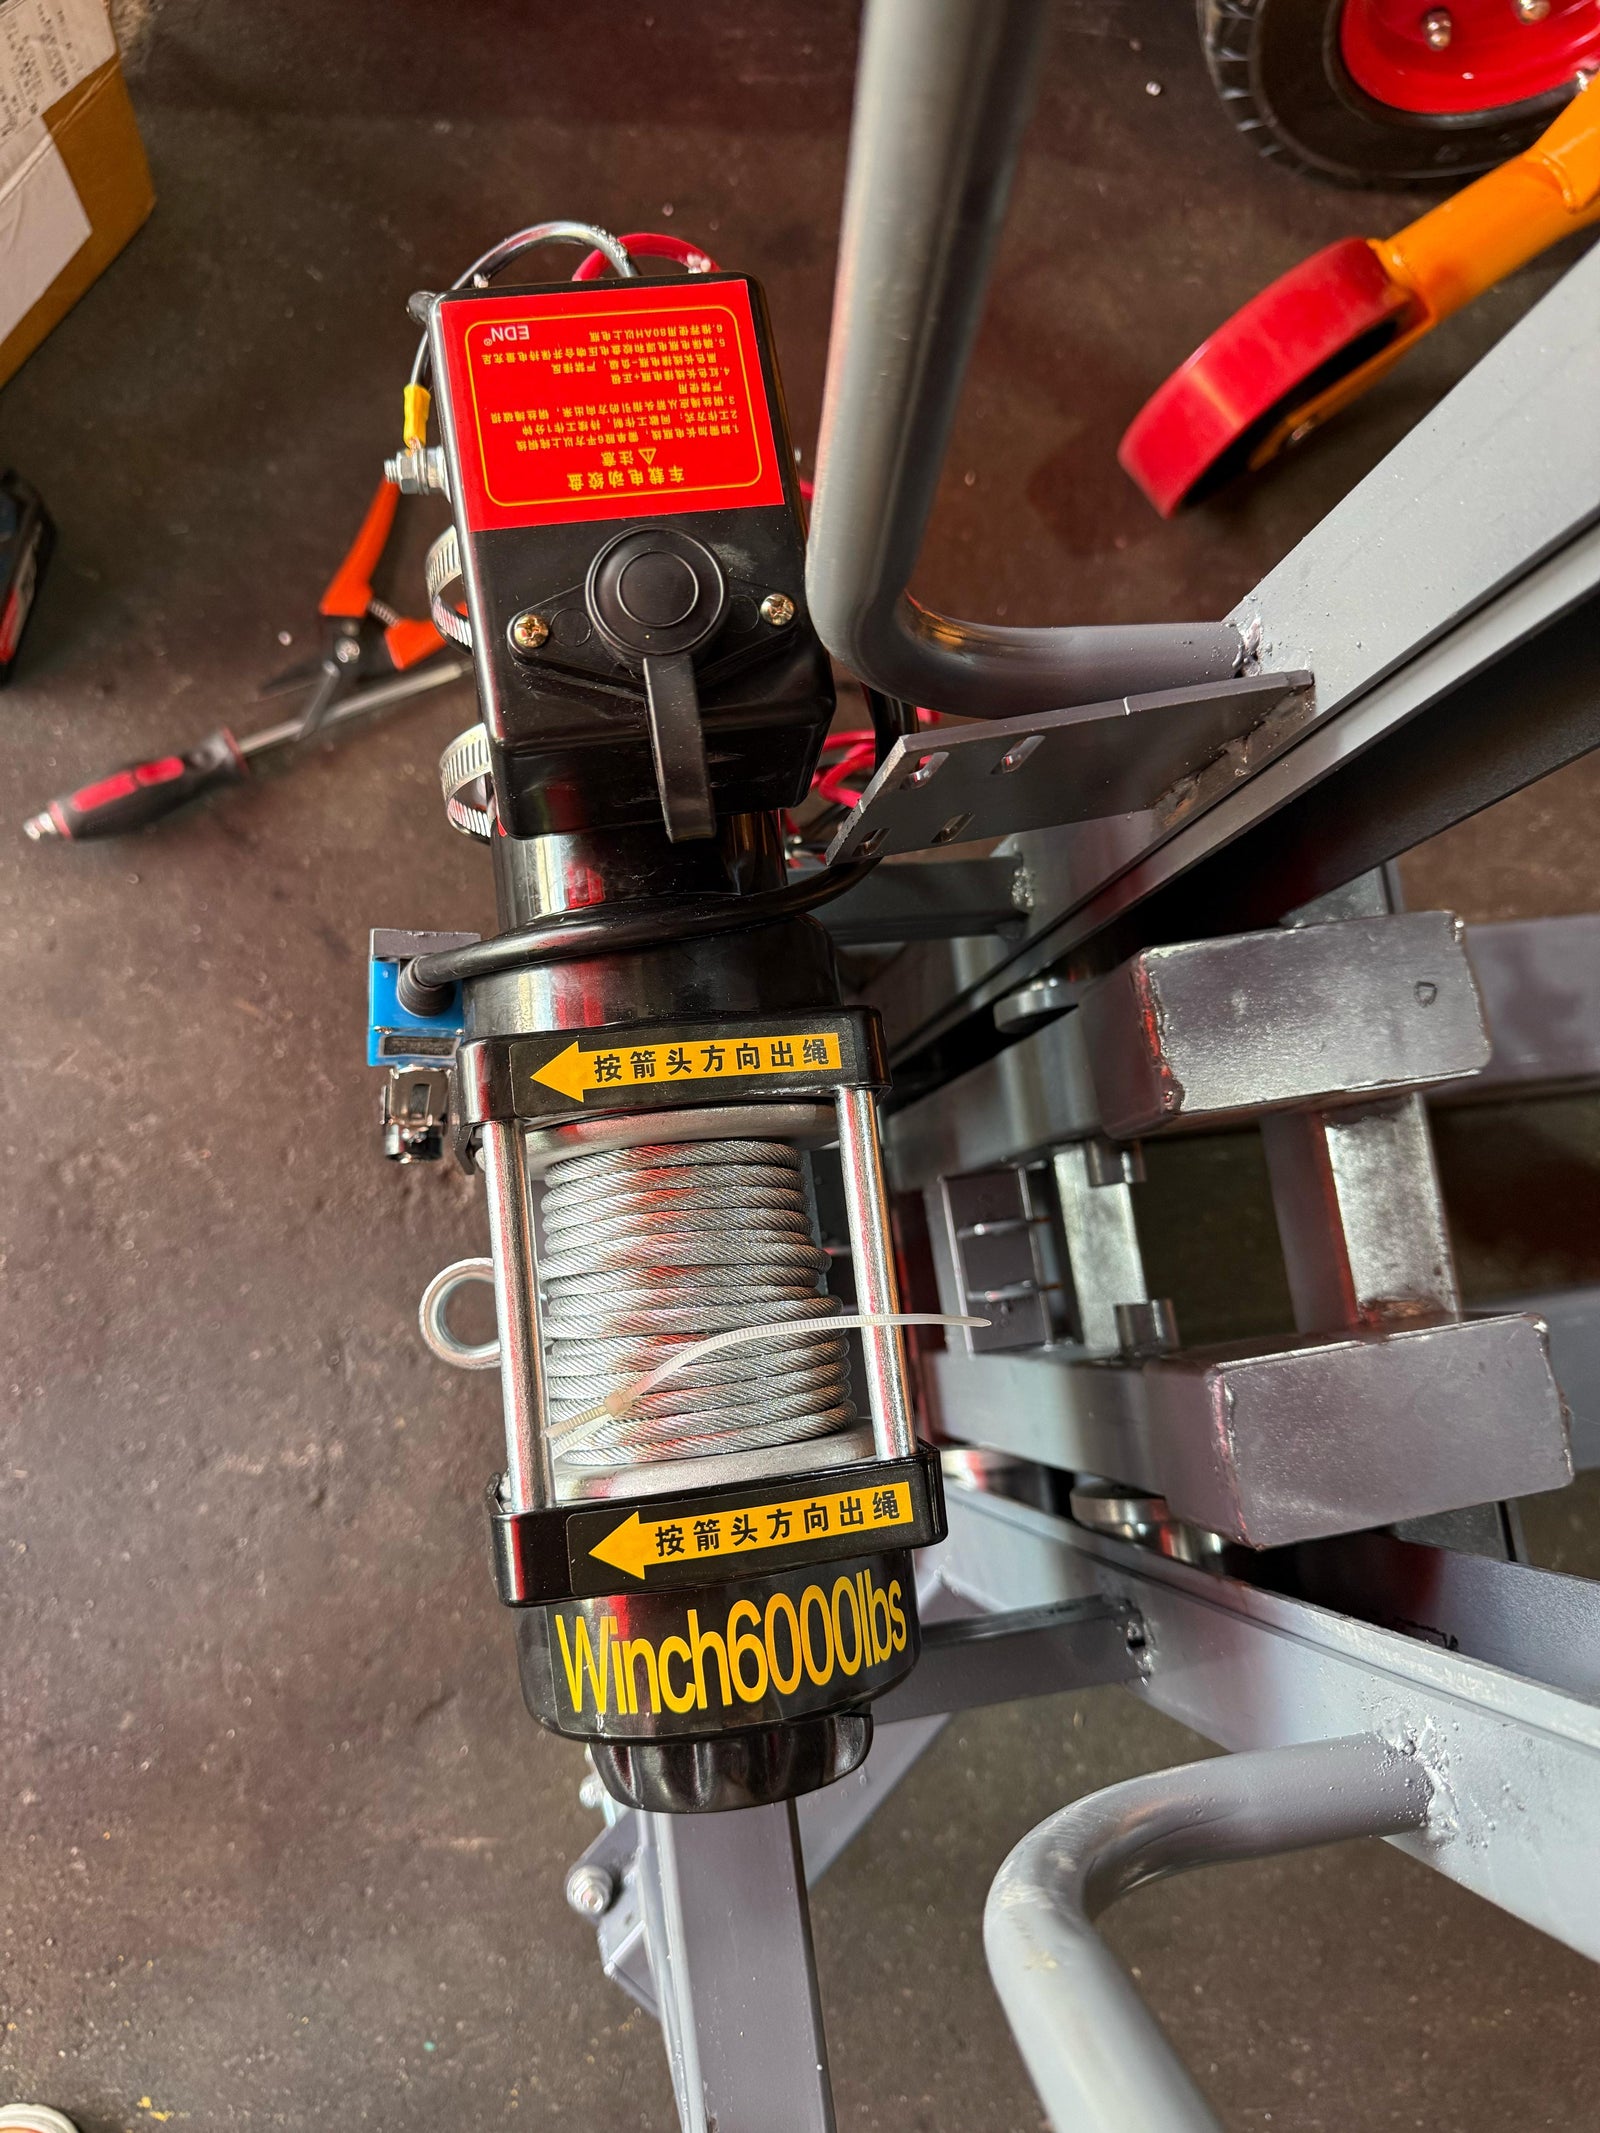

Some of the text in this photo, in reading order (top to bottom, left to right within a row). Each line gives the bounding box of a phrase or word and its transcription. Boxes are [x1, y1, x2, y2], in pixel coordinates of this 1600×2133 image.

[678, 380, 722, 394] 严禁使用
[600, 449, 634, 466] 注意
[566, 464, 685, 491] 车载电动绞盘
[593, 1038, 831, 1083] 按箭头方向出绳
[655, 1490, 901, 1558] 按箭头方向出绳
[555, 1568, 908, 1716] Winch6000lbs
